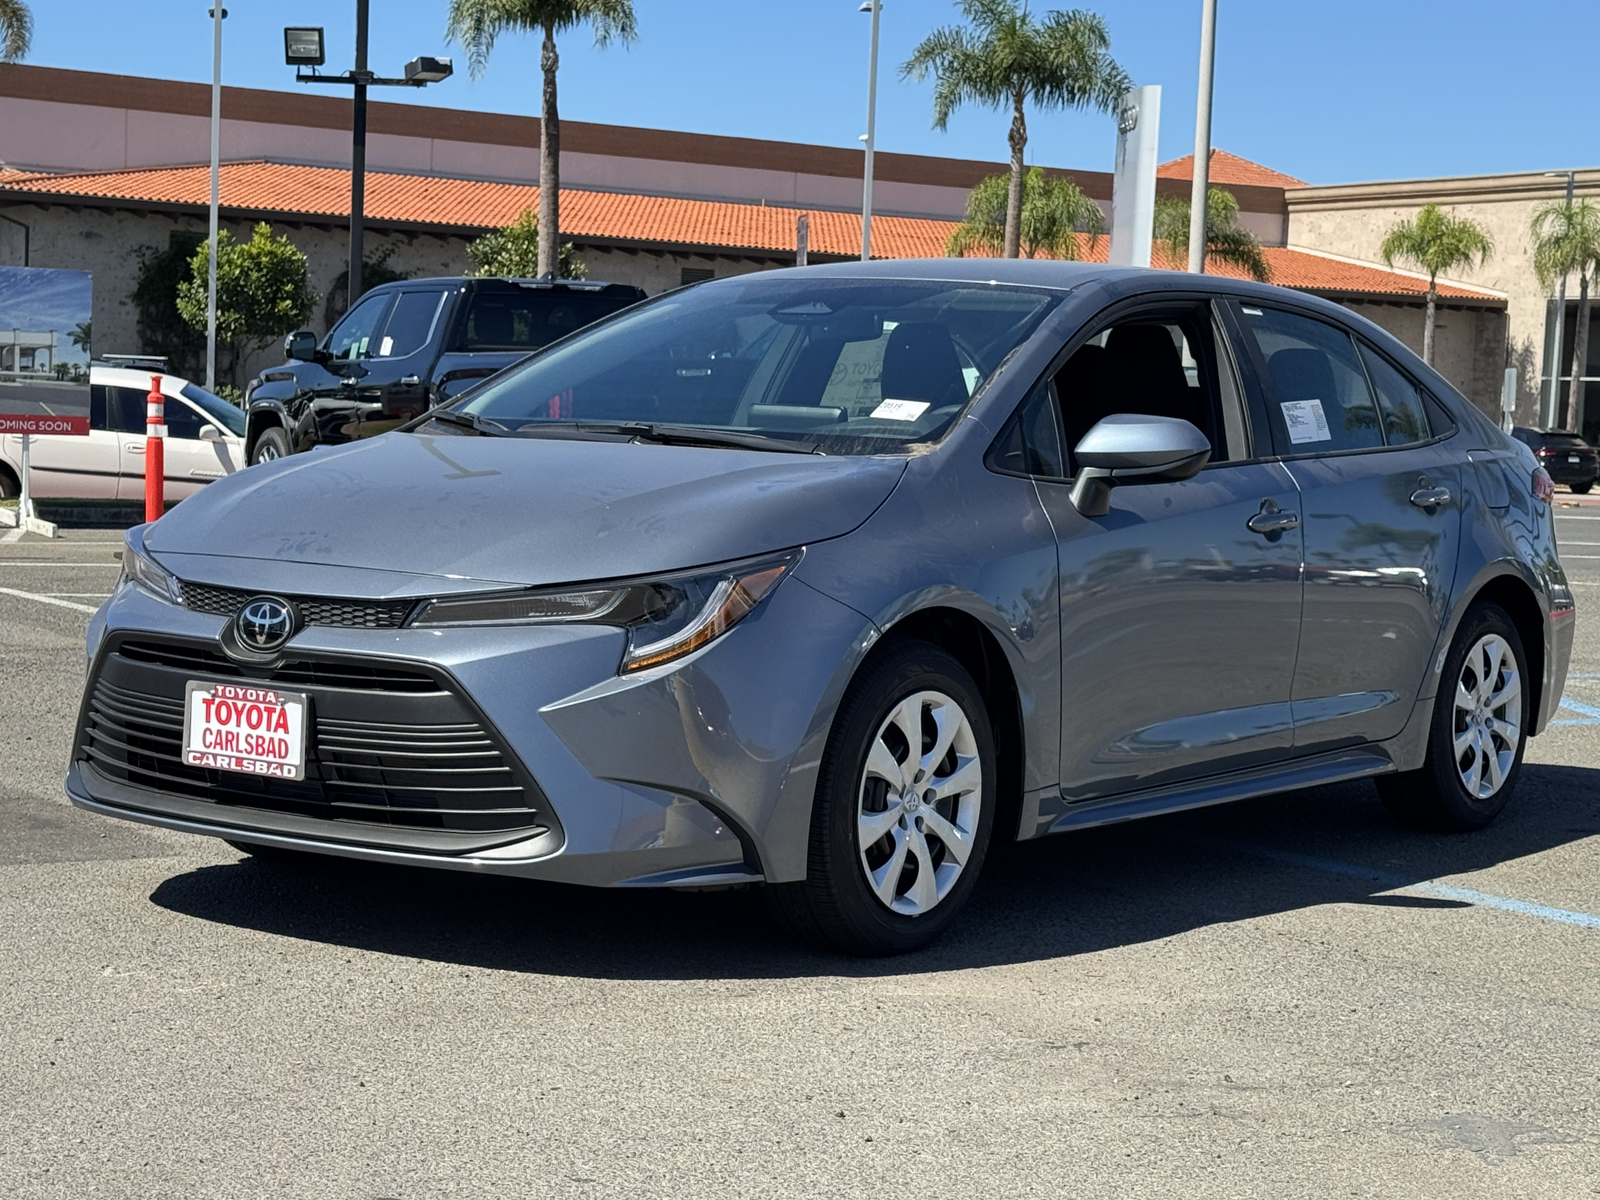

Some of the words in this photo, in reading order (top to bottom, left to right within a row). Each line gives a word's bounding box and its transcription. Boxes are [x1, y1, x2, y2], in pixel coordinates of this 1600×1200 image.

[852, 363, 881, 375] TOYO
[0, 419, 36, 430] OMING
[39, 421, 72, 431] SOON
[215, 685, 277, 703] TOYOTA
[202, 697, 290, 735] TOYOTA
[202, 727, 290, 760] CARLSBAD
[187, 751, 297, 778] CARLSBAD
